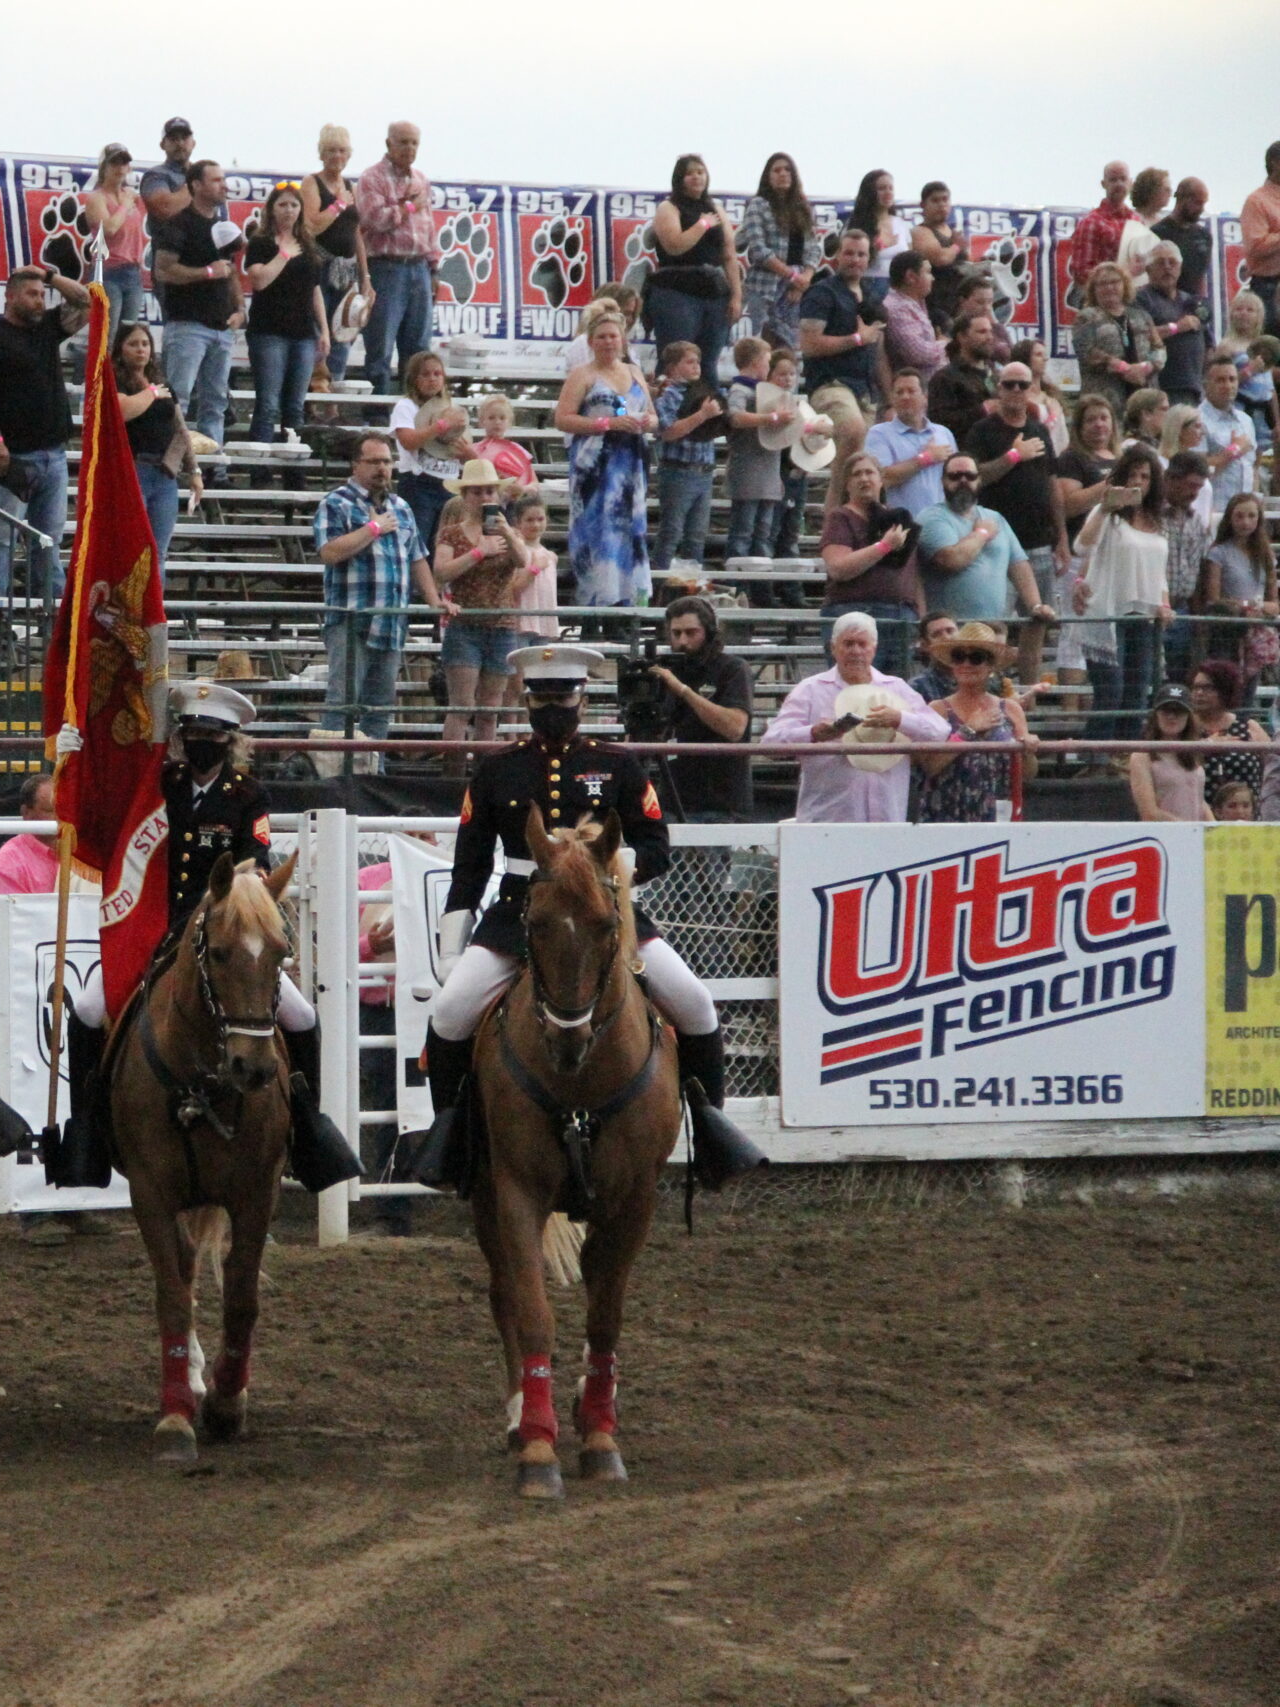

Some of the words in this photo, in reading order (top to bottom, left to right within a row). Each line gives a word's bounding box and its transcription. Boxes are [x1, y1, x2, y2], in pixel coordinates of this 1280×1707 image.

[439, 306, 501, 336] WOLF
[813, 837, 1171, 1015] Ultra
[930, 945, 1177, 1058] Fencing
[869, 1075, 1124, 1110] 530.241.3366
